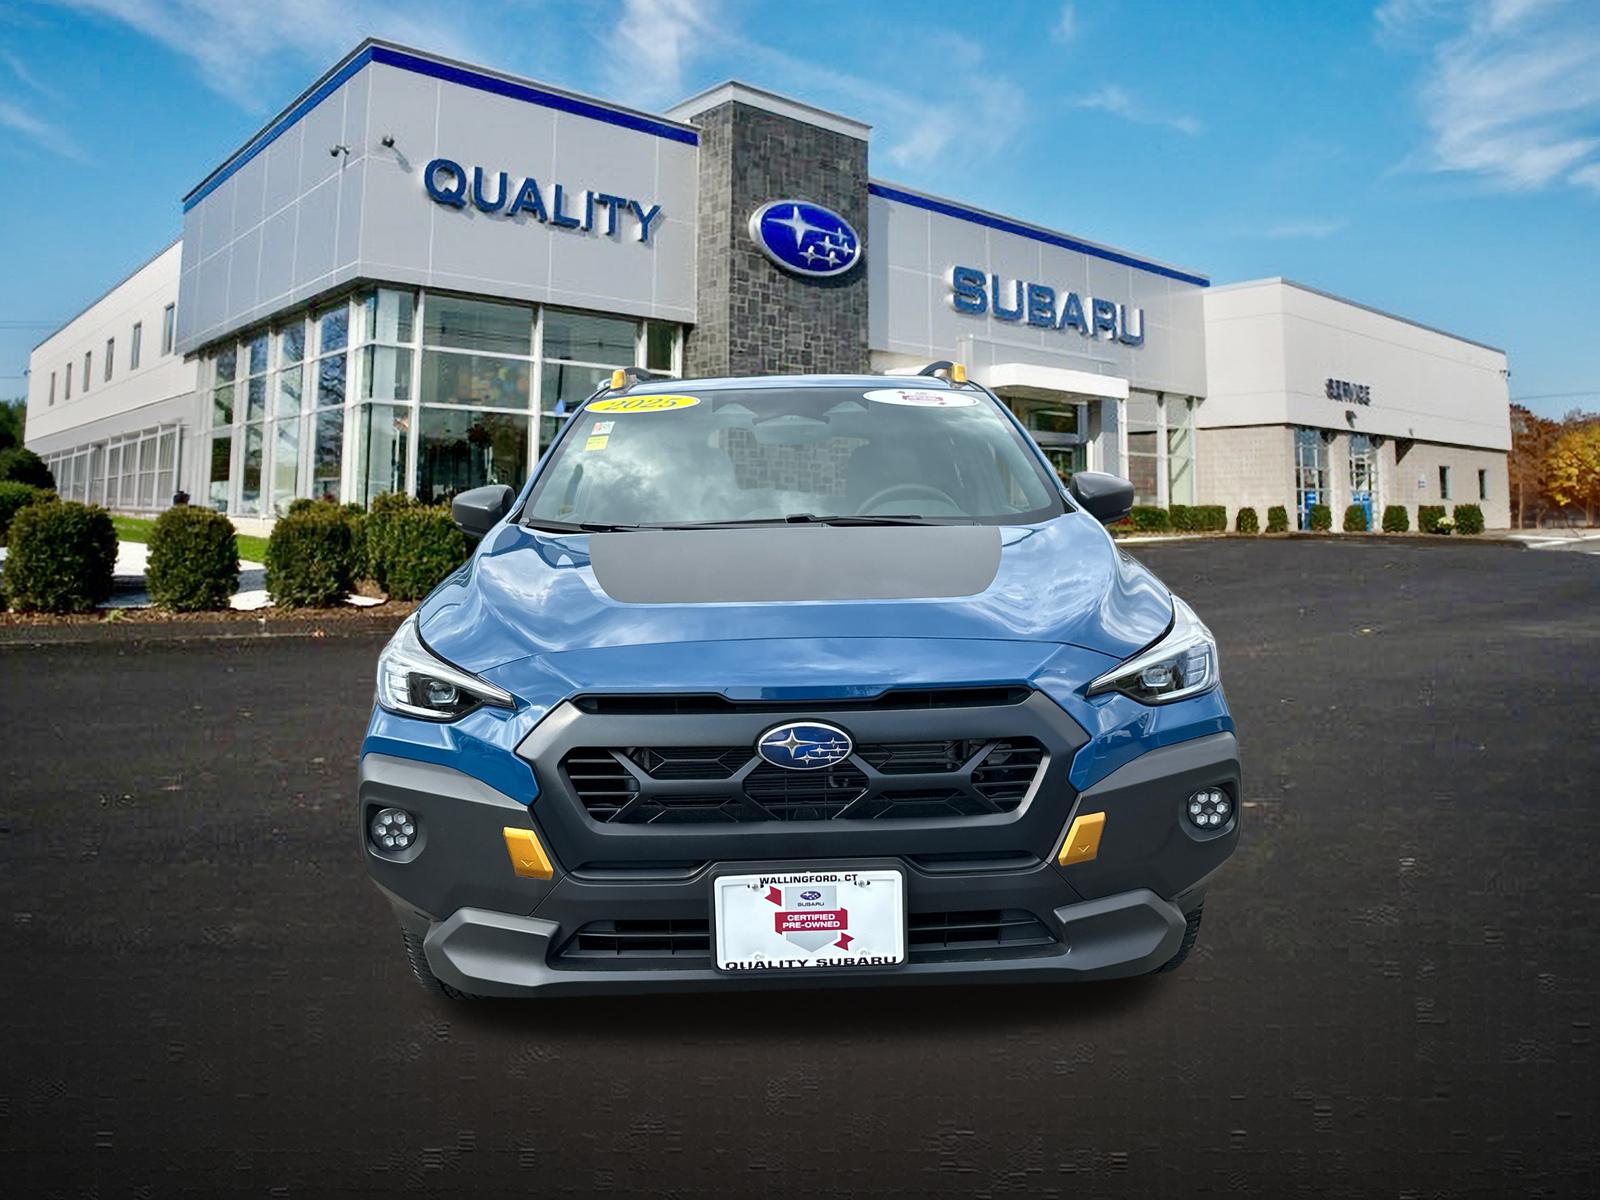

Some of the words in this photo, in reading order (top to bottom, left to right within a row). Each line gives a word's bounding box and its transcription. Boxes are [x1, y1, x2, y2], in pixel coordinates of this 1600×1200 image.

[424, 158, 661, 242] QUALITY
[952, 265, 1145, 346] SUBARU
[1325, 378, 1371, 407] SERVICE
[603, 398, 682, 410] 2025
[845, 873, 858, 882] CT
[787, 913, 836, 921] CERTIFIED
[782, 920, 841, 929] PRE-OWNED
[725, 959, 809, 970] QUALITY
[816, 956, 897, 967] SUBARU
